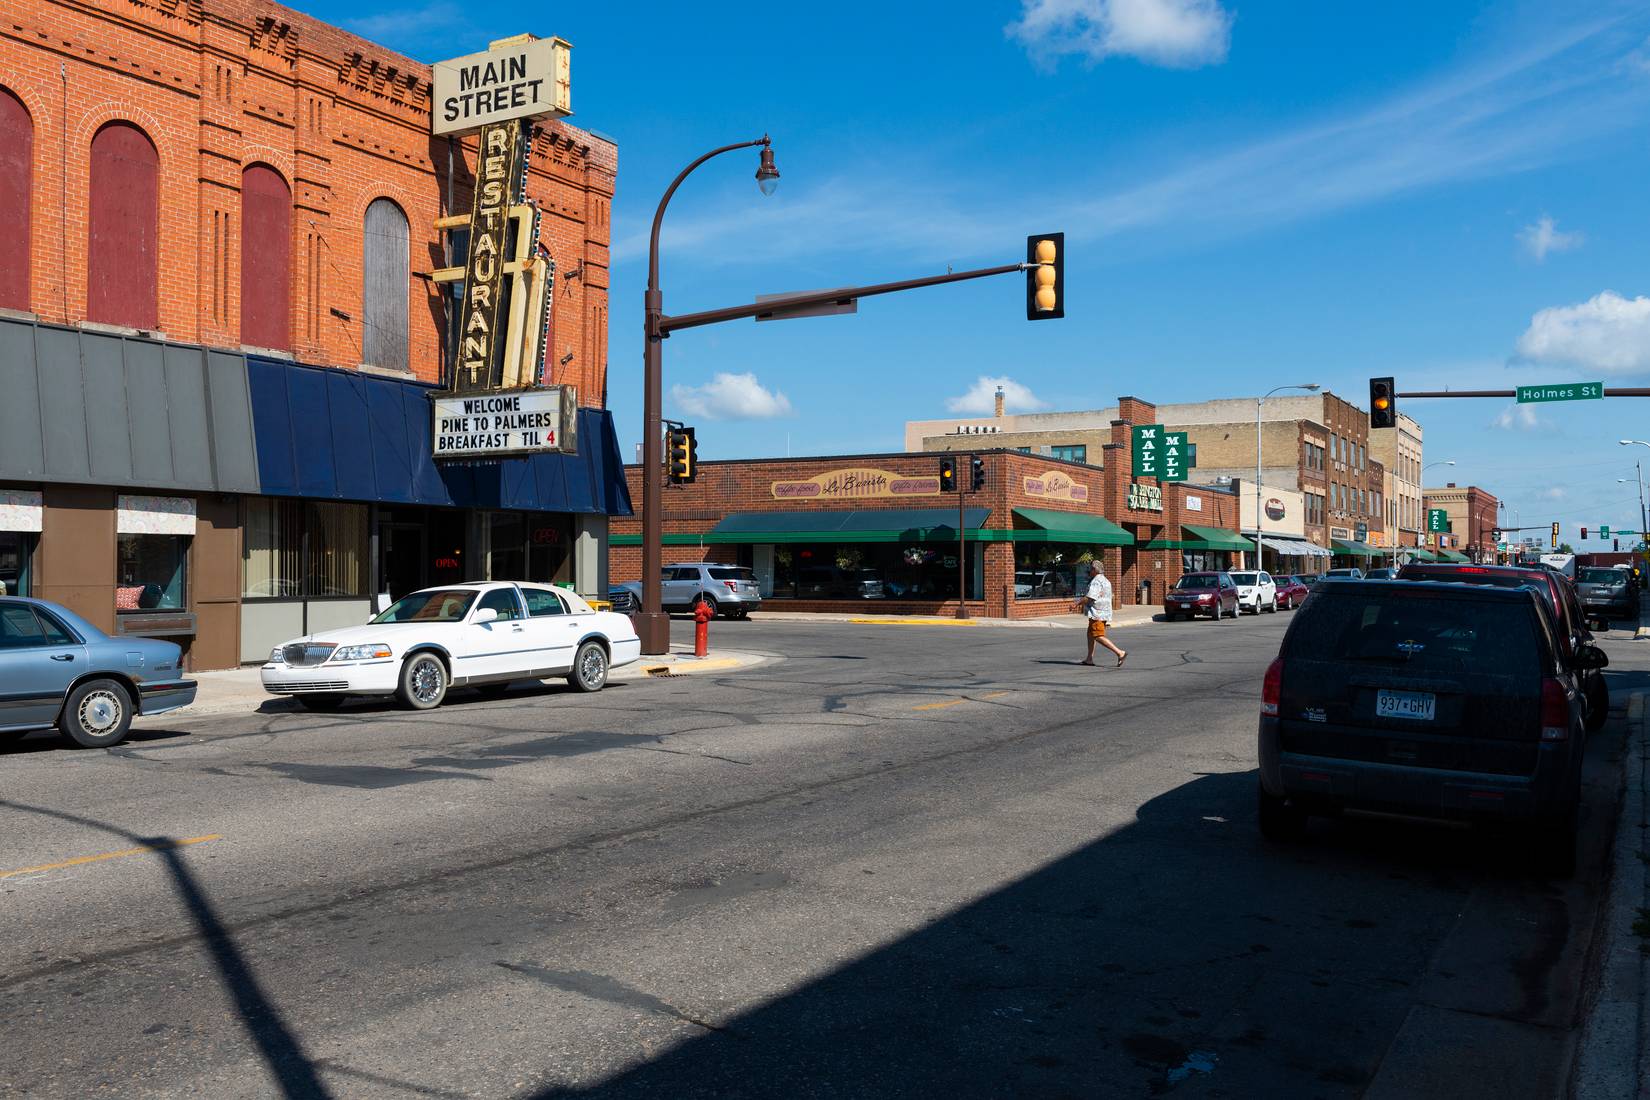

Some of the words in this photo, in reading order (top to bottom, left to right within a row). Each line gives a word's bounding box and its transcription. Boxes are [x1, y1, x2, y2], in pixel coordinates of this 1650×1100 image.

[460, 54, 527, 91] MAIN
[444, 78, 544, 122] STREET
[464, 128, 509, 385] RESTAURANT
[1523, 389, 1574, 399] Holmes
[1582, 385, 1597, 396] St
[464, 397, 521, 414] WELCOME
[441, 418, 469, 433] PINE
[474, 416, 489, 431] TO
[495, 412, 551, 430] PALMERS
[439, 433, 510, 450] BREAKFAST
[522, 431, 541, 446] TIL
[546, 430, 555, 445] 4
[1141, 429, 1156, 472] MALL
[1165, 436, 1180, 477] MALL
[842, 475, 887, 491] Barista
[534, 527, 560, 545] OPEN
[435, 558, 459, 569] OPEN
[1381, 696, 1402, 711] 937
[1410, 698, 1432, 713] GHV
